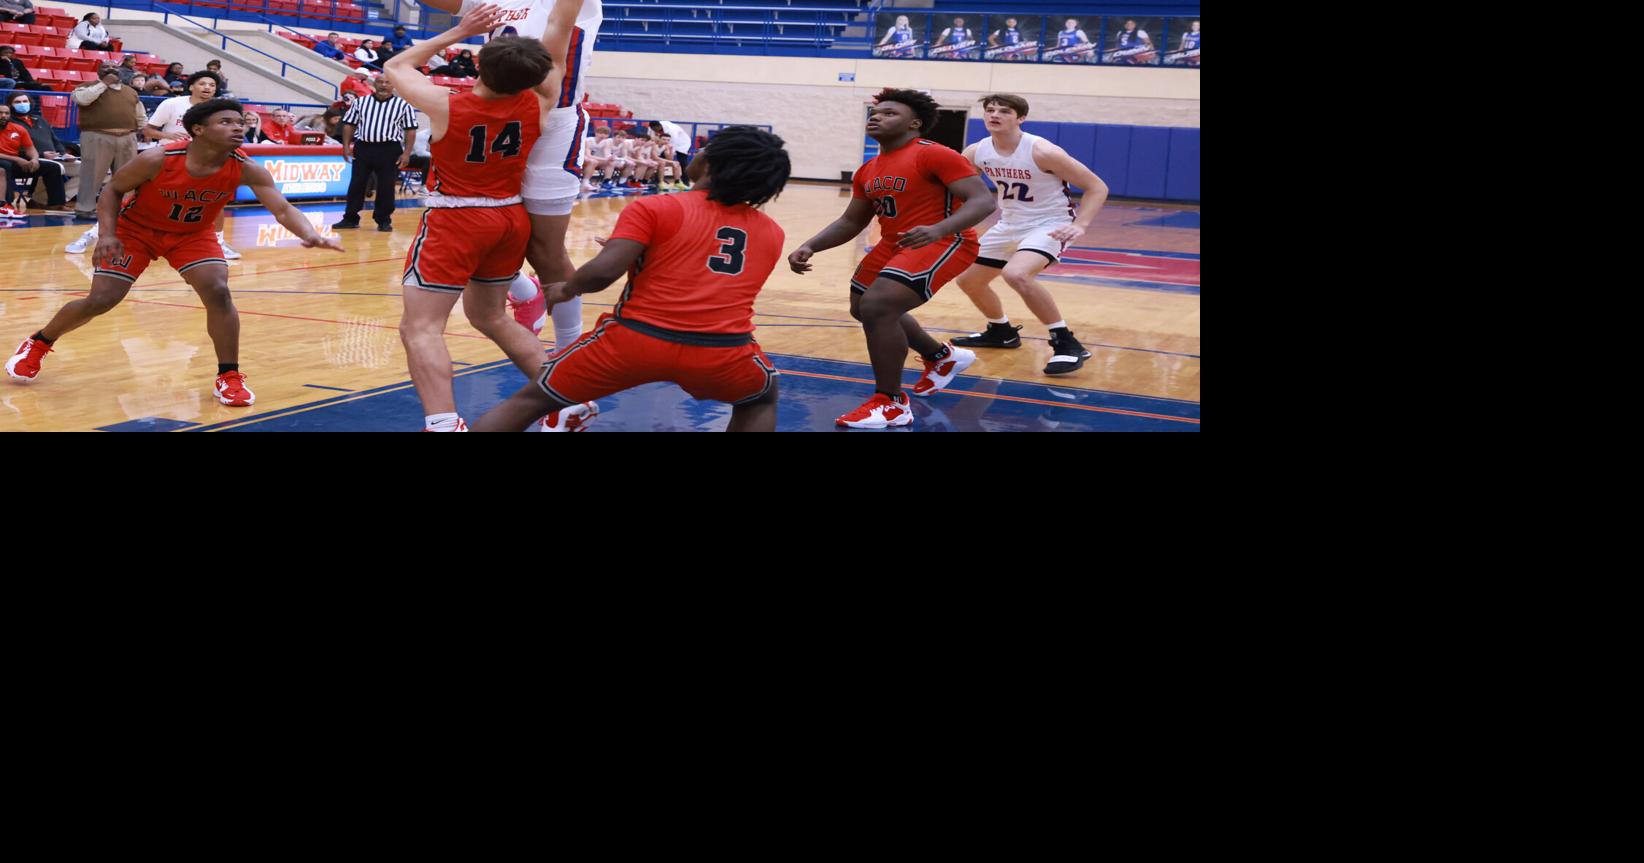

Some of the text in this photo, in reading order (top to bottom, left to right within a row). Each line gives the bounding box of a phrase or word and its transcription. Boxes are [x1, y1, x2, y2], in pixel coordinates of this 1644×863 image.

[1061, 38, 1068, 46] 3
[465, 121, 521, 164] 14
[264, 160, 346, 183] MIDWAY
[984, 167, 1032, 180] PANTHERS
[996, 180, 1034, 202] 22
[168, 203, 205, 223] 12
[706, 226, 749, 276] 3
